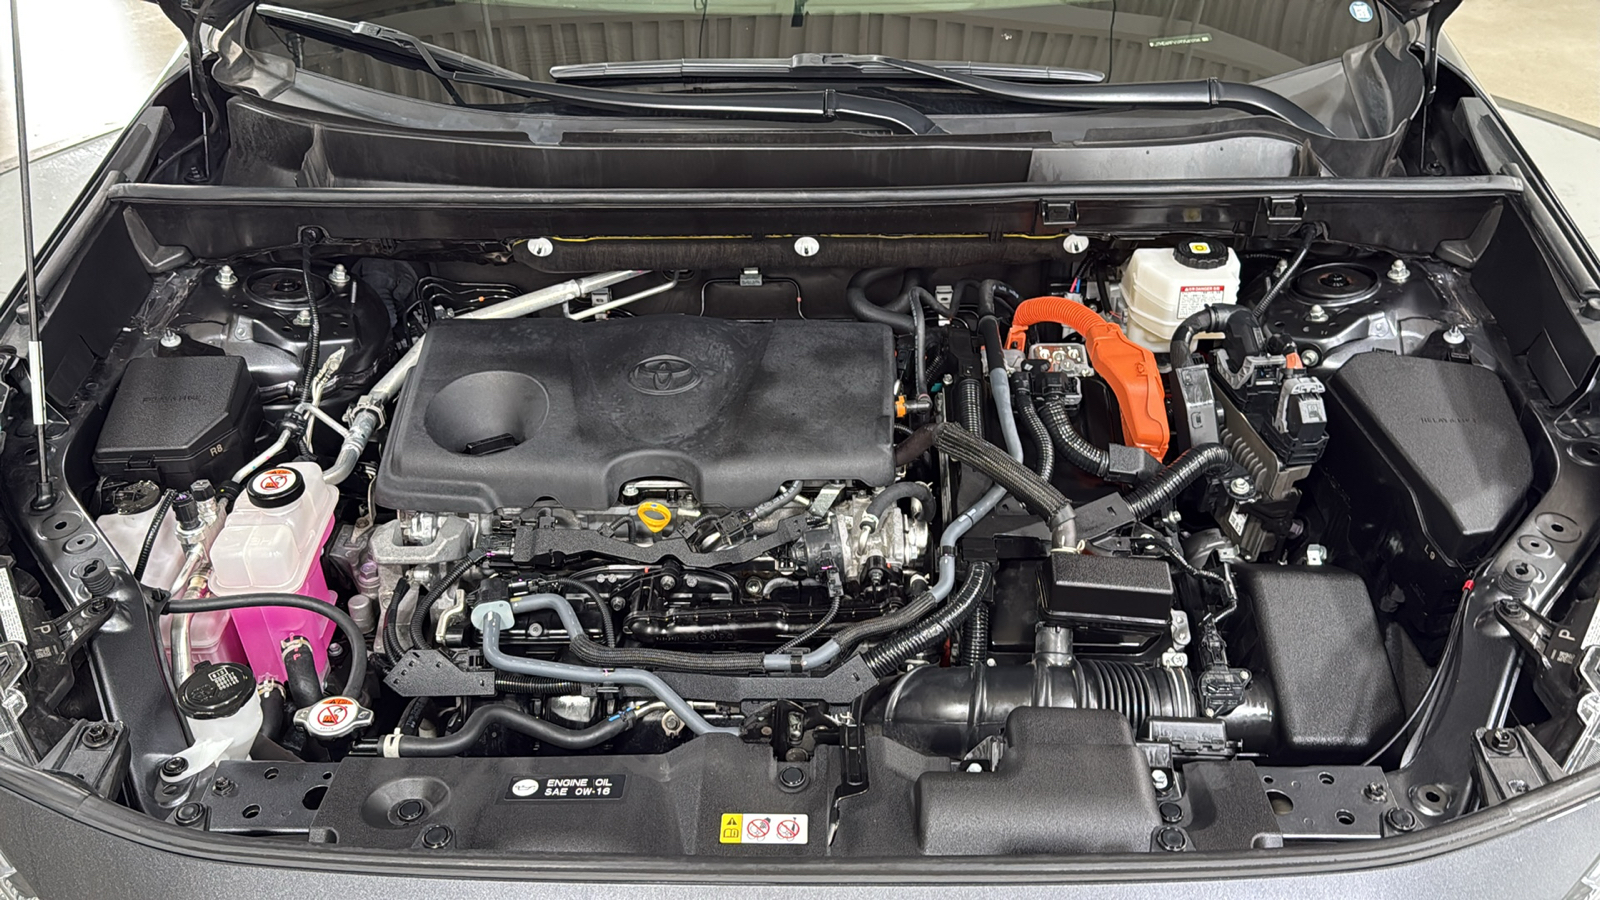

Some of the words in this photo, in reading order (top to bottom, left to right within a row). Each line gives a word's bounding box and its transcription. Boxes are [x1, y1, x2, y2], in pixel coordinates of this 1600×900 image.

[209, 443, 223, 457] R8
[33, 624, 51, 634] P
[1558, 629, 1576, 642] P
[547, 779, 588, 787] ENGINE
[595, 779, 613, 787] OIL
[544, 788, 568, 796] SAE
[575, 788, 610, 796] 0W-16
